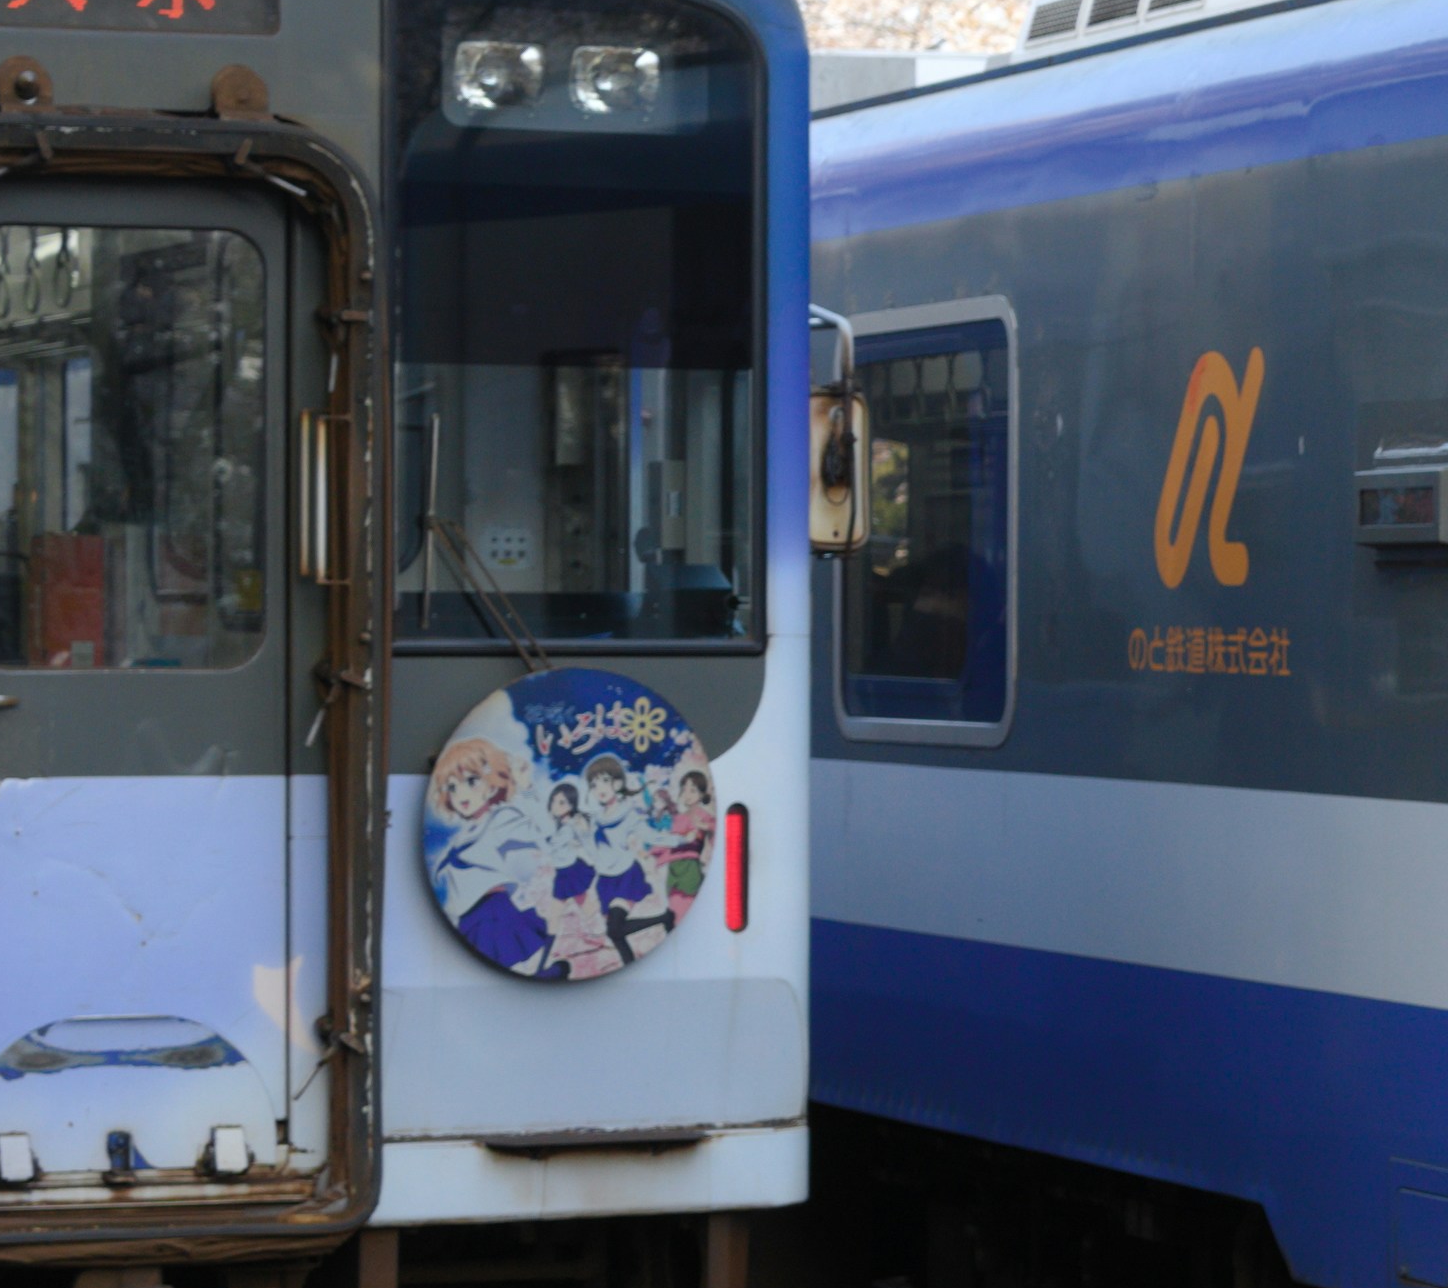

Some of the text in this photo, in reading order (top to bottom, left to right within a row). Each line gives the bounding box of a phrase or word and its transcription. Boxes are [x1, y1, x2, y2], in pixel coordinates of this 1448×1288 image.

[1128, 625, 1291, 676] のと鉄道株式会社
